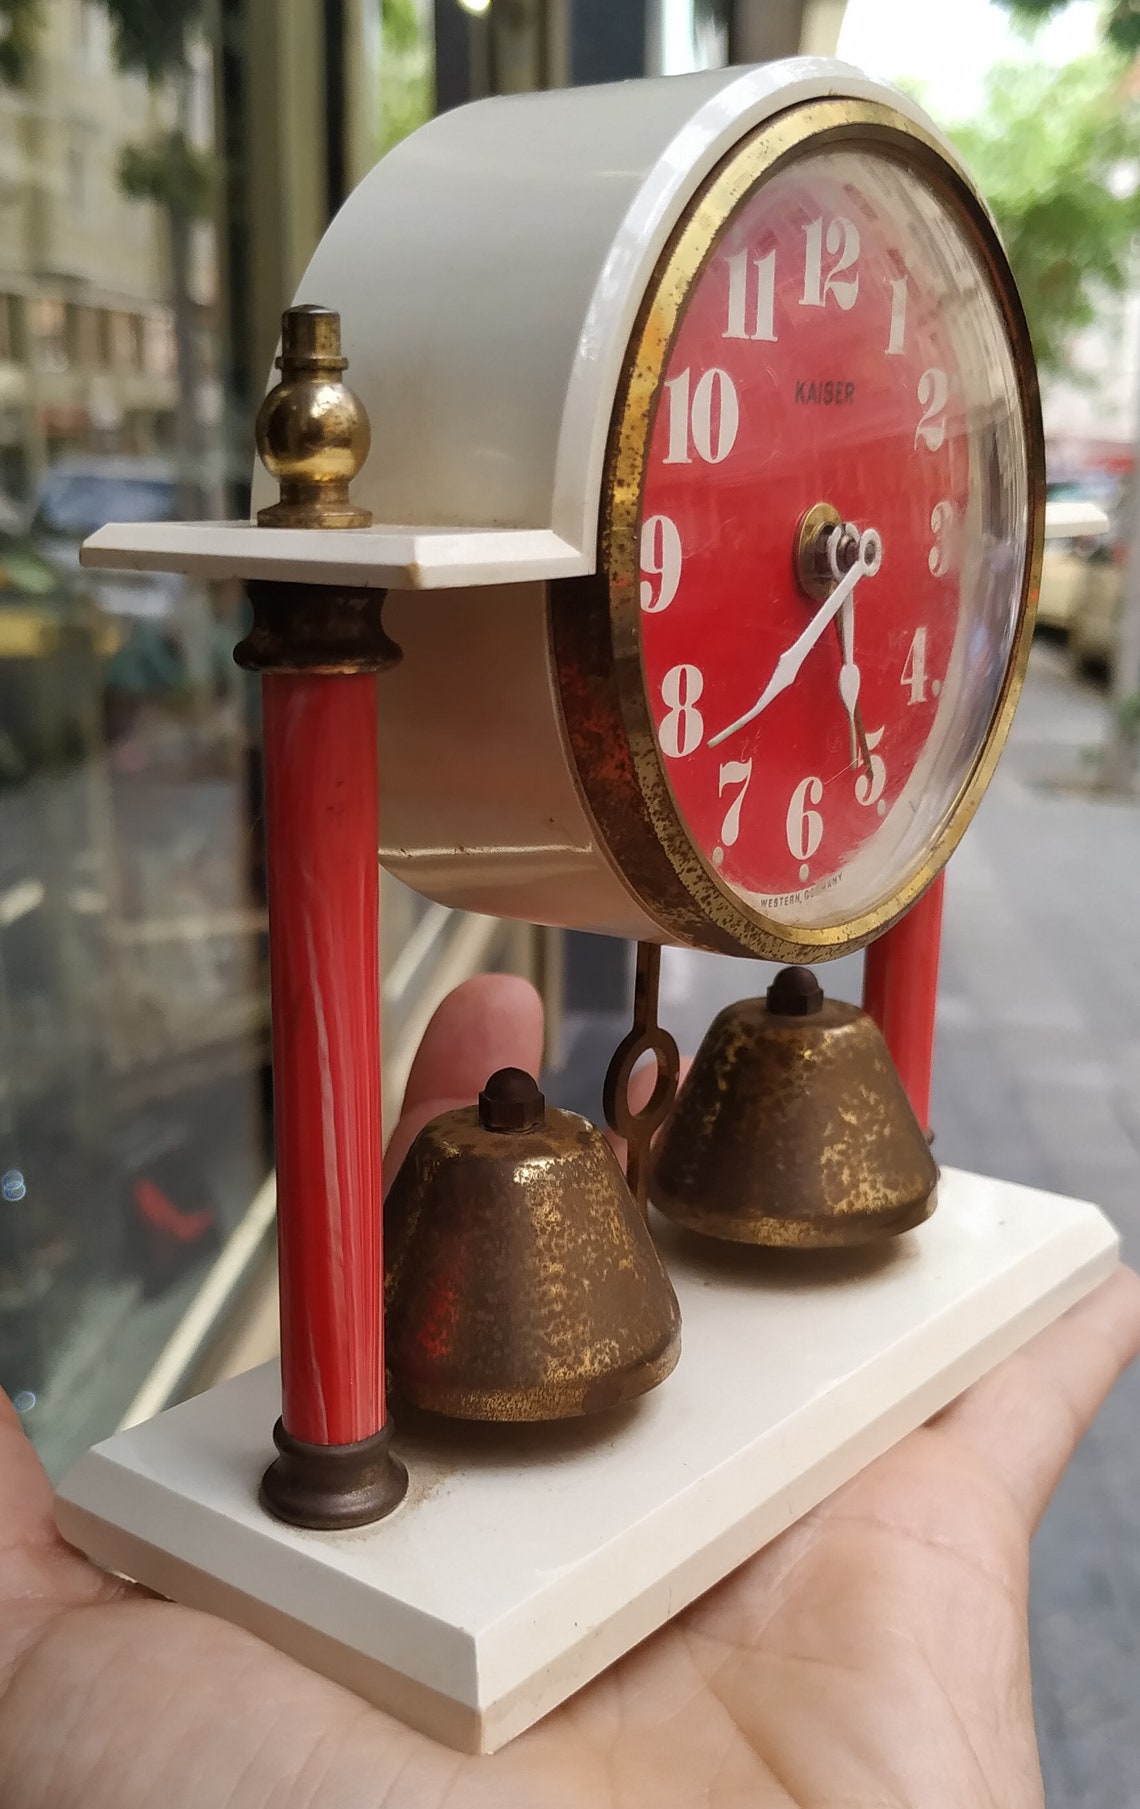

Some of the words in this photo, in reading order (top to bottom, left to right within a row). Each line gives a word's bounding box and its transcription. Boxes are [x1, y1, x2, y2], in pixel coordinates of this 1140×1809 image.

[722, 248, 778, 342] 11
[799, 217, 860, 310] 12
[882, 275, 907, 355] 1
[662, 367, 739, 464] 10
[795, 380, 855, 405] KAISER
[914, 368, 948, 451] 2
[640, 515, 682, 613] 9
[928, 501, 952, 577] 3
[900, 626, 927, 706] 4
[658, 664, 704, 758] 8
[719, 757, 752, 846] 7
[855, 725, 886, 806] 5
[786, 776, 823, 860] 6
